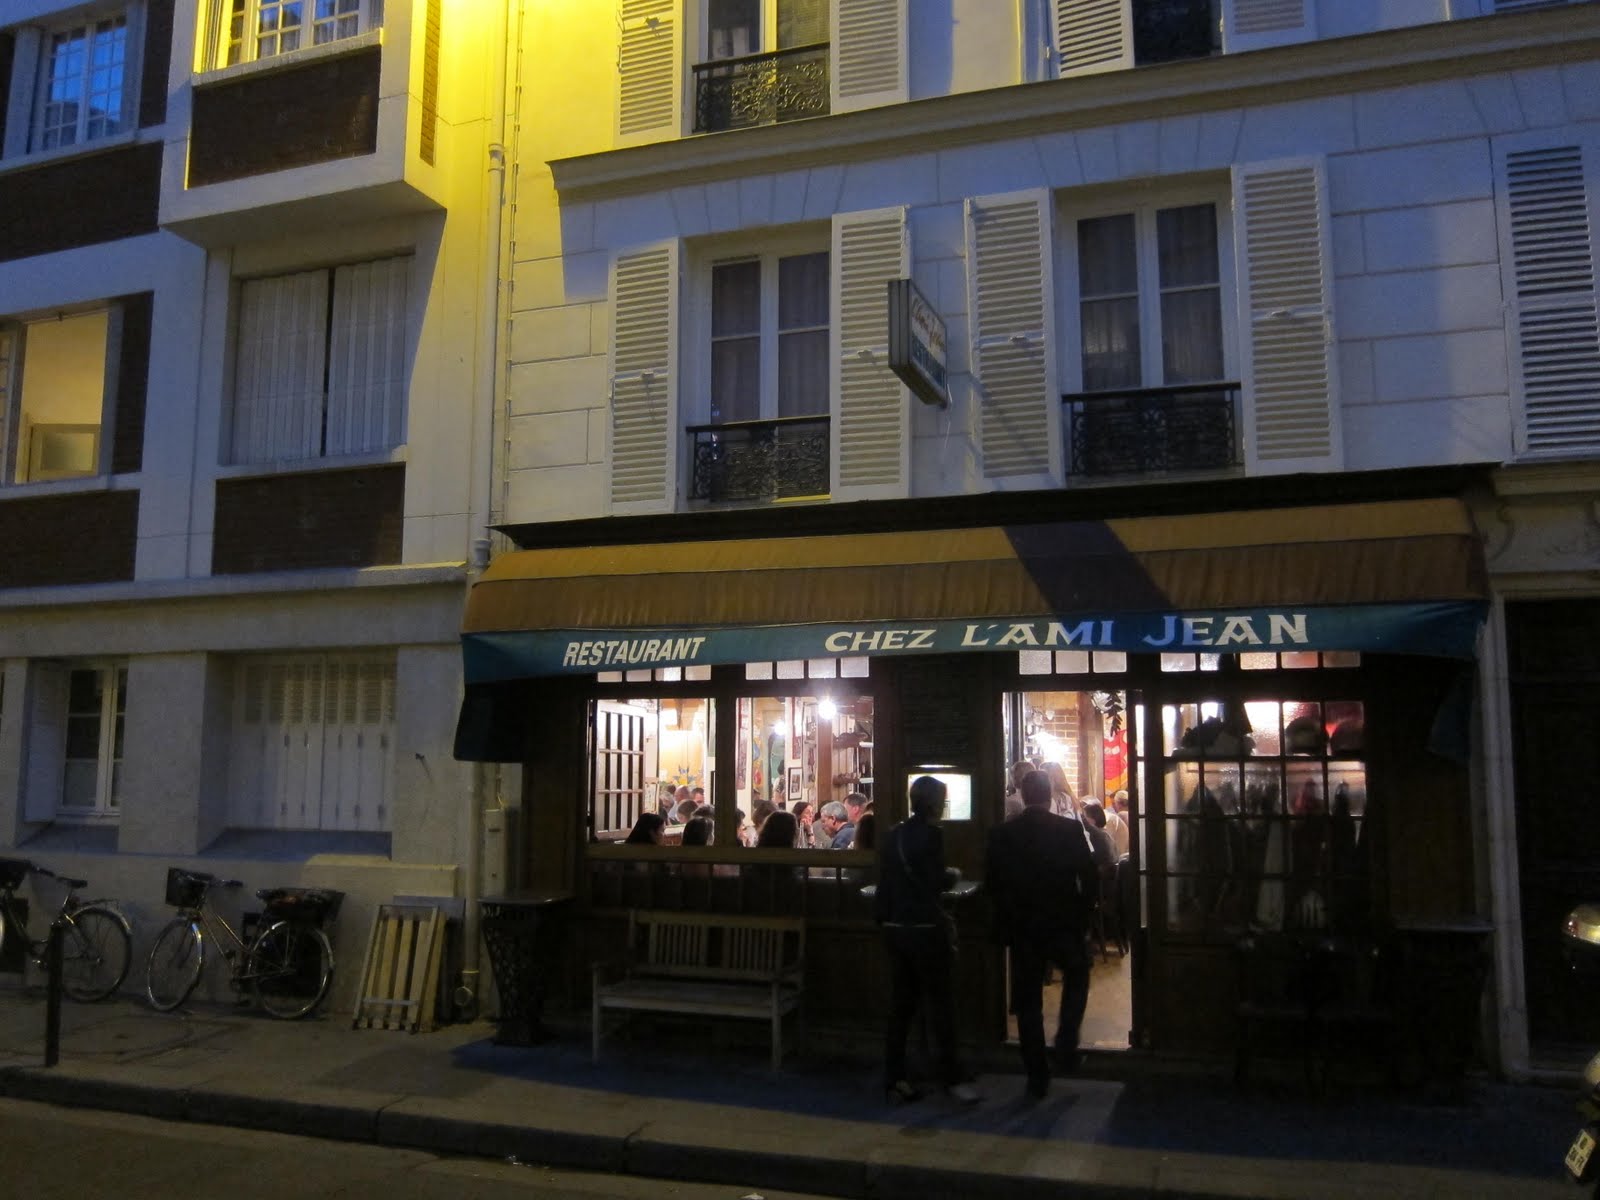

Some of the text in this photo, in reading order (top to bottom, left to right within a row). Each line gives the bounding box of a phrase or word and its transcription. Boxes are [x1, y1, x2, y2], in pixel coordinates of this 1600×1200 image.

[825, 614, 1309, 651] CHEZ L'AMI JEAN
[563, 637, 705, 666] RESTAURANT
